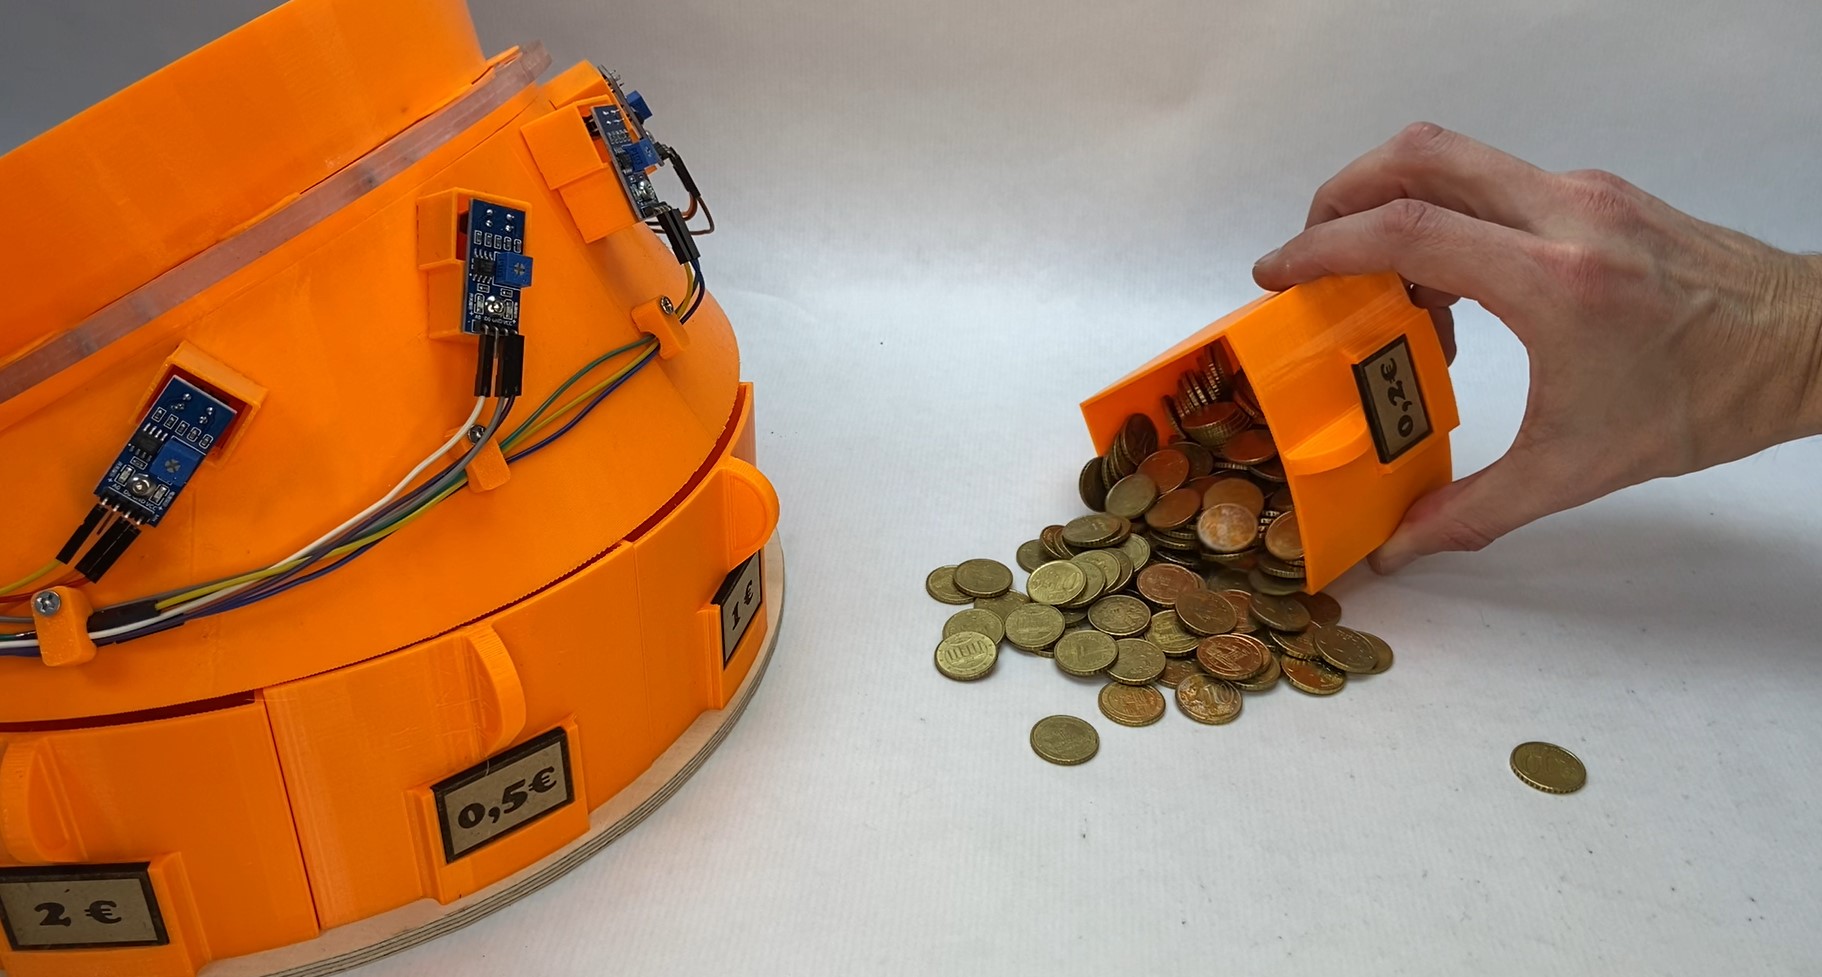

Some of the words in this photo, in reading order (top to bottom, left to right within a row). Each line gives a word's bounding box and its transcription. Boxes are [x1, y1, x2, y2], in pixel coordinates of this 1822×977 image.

[1380, 357, 1414, 438] 0,2€
[457, 765, 557, 829] 0,5€
[34, 902, 72, 927] 2
